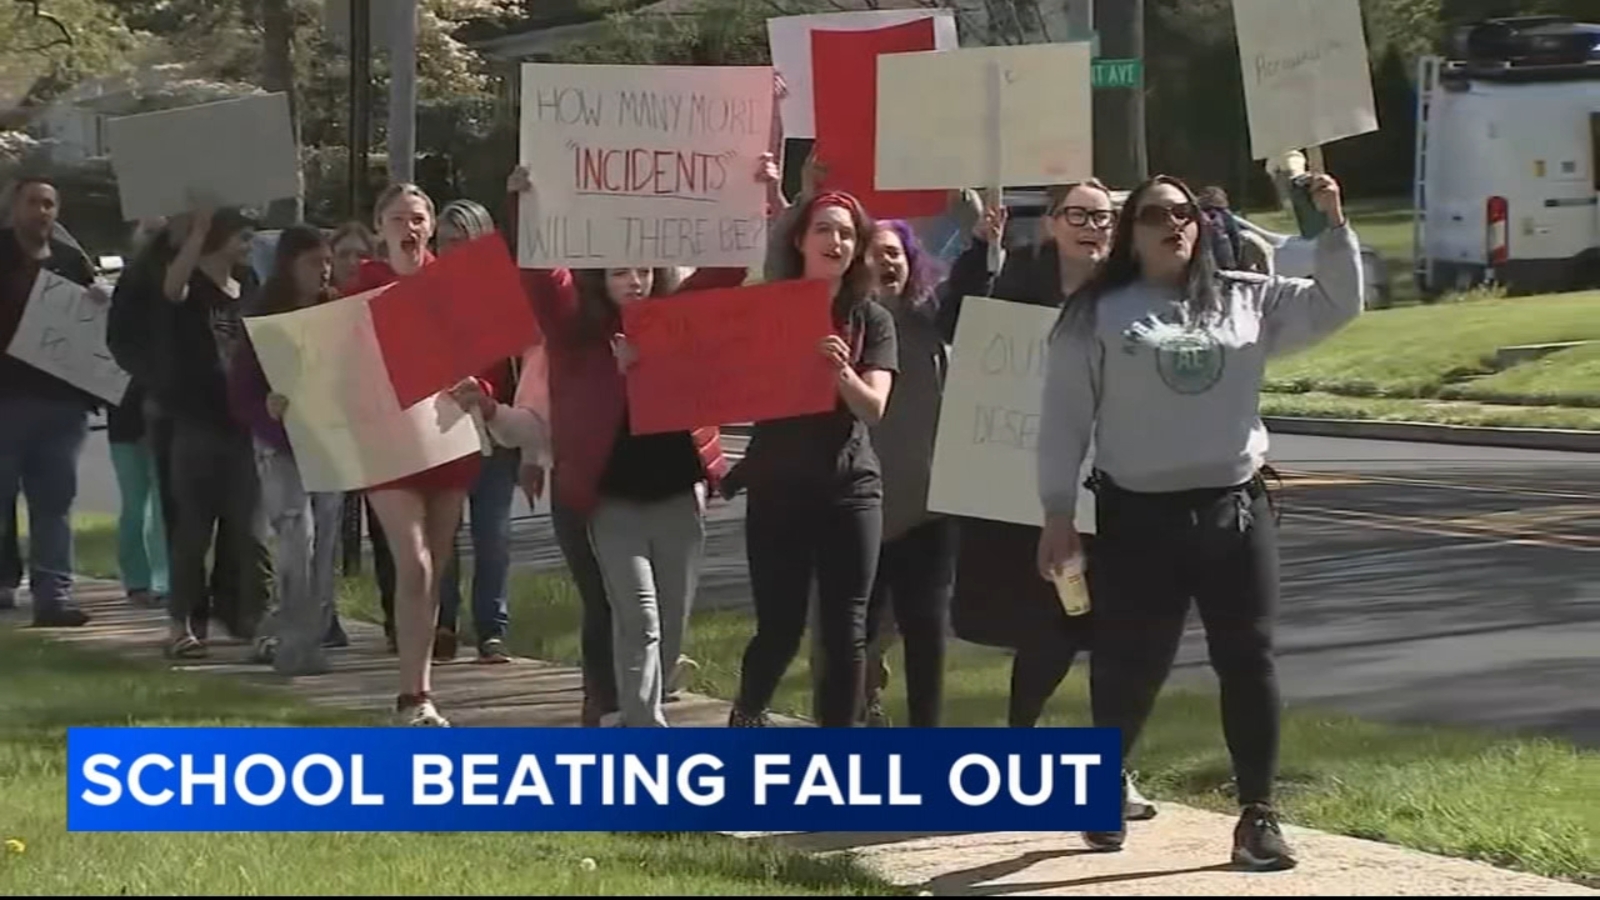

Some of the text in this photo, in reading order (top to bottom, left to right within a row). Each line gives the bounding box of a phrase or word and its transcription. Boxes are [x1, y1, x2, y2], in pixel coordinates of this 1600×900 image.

[1107, 64, 1135, 85] AVE
[536, 87, 601, 127] HOW
[617, 90, 682, 132] MANY
[527, 215, 765, 259] WILL THERE BE?
